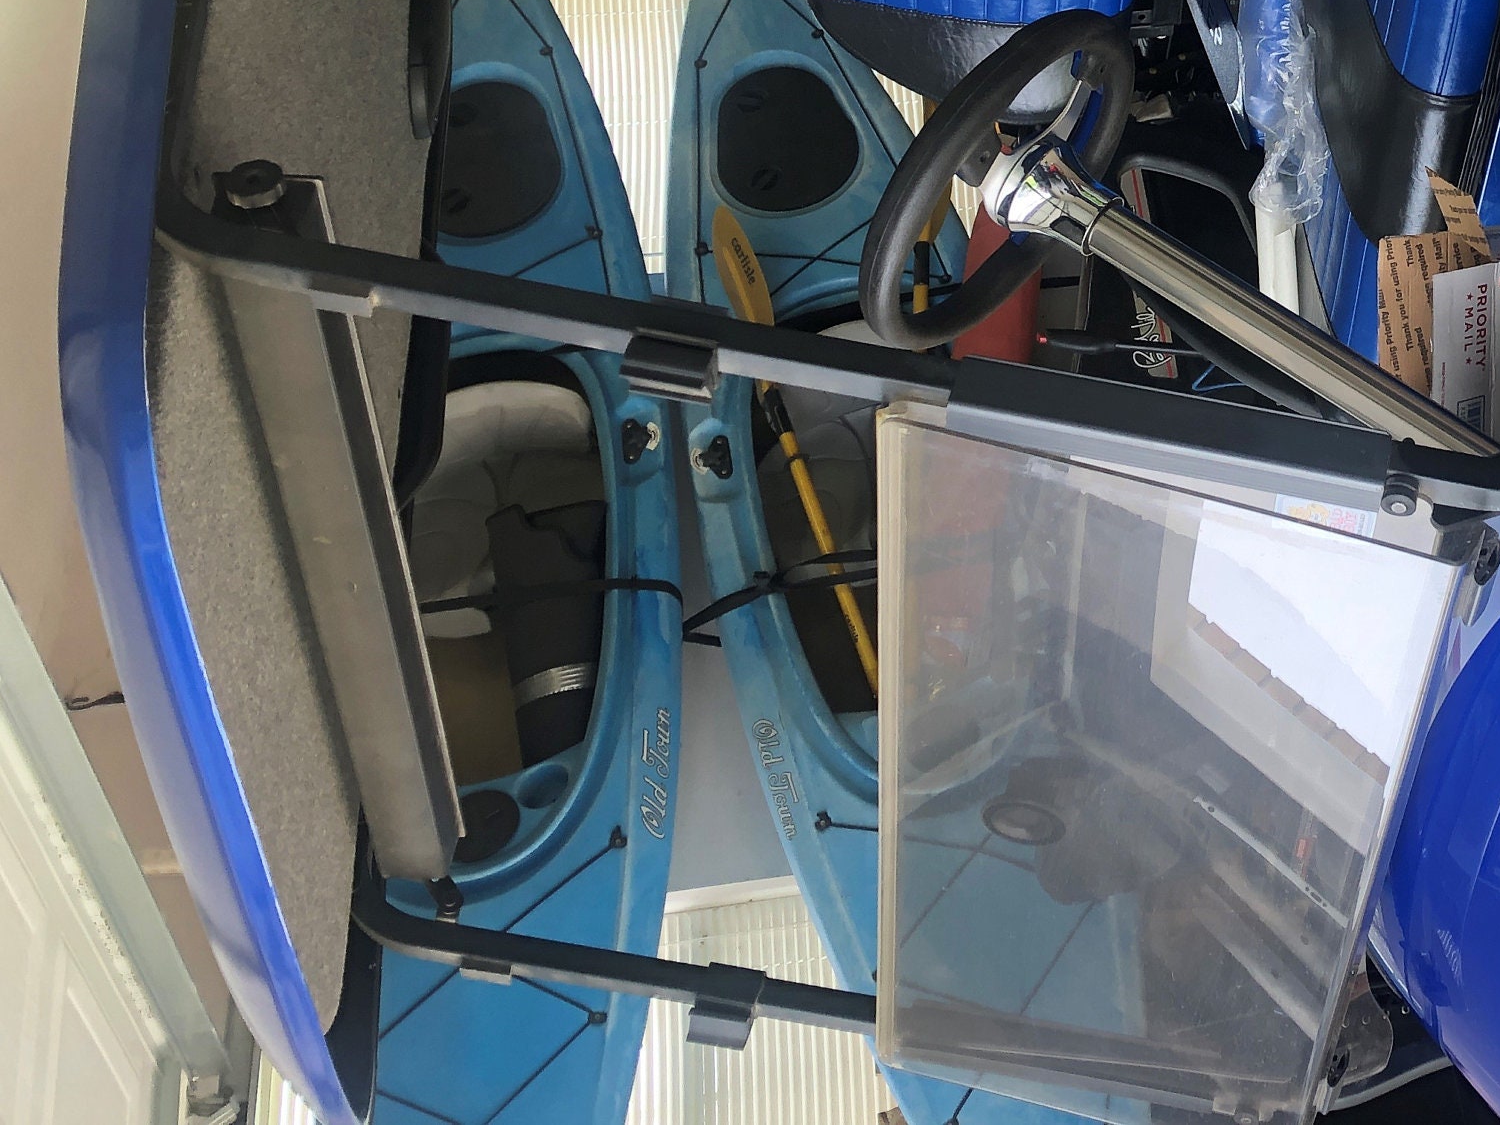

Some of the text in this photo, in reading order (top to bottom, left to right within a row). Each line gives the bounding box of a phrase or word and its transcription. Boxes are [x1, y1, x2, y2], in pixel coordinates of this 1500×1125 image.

[731, 237, 756, 284] carlisle
[1403, 240, 1414, 267] Thank
[1415, 243, 1430, 281] required
[1390, 262, 1400, 287] using
[1395, 286, 1403, 302] for
[1399, 303, 1409, 320] you
[1381, 311, 1393, 345] Priority
[1402, 321, 1414, 352] Thank
[1464, 307, 1474, 352] MAIL
[1475, 284, 1488, 367] PRIORITY
[1390, 346, 1399, 372] using
[1414, 327, 1429, 366] required
[641, 707, 672, 839] Old Town
[752, 718, 798, 840] Old Town
